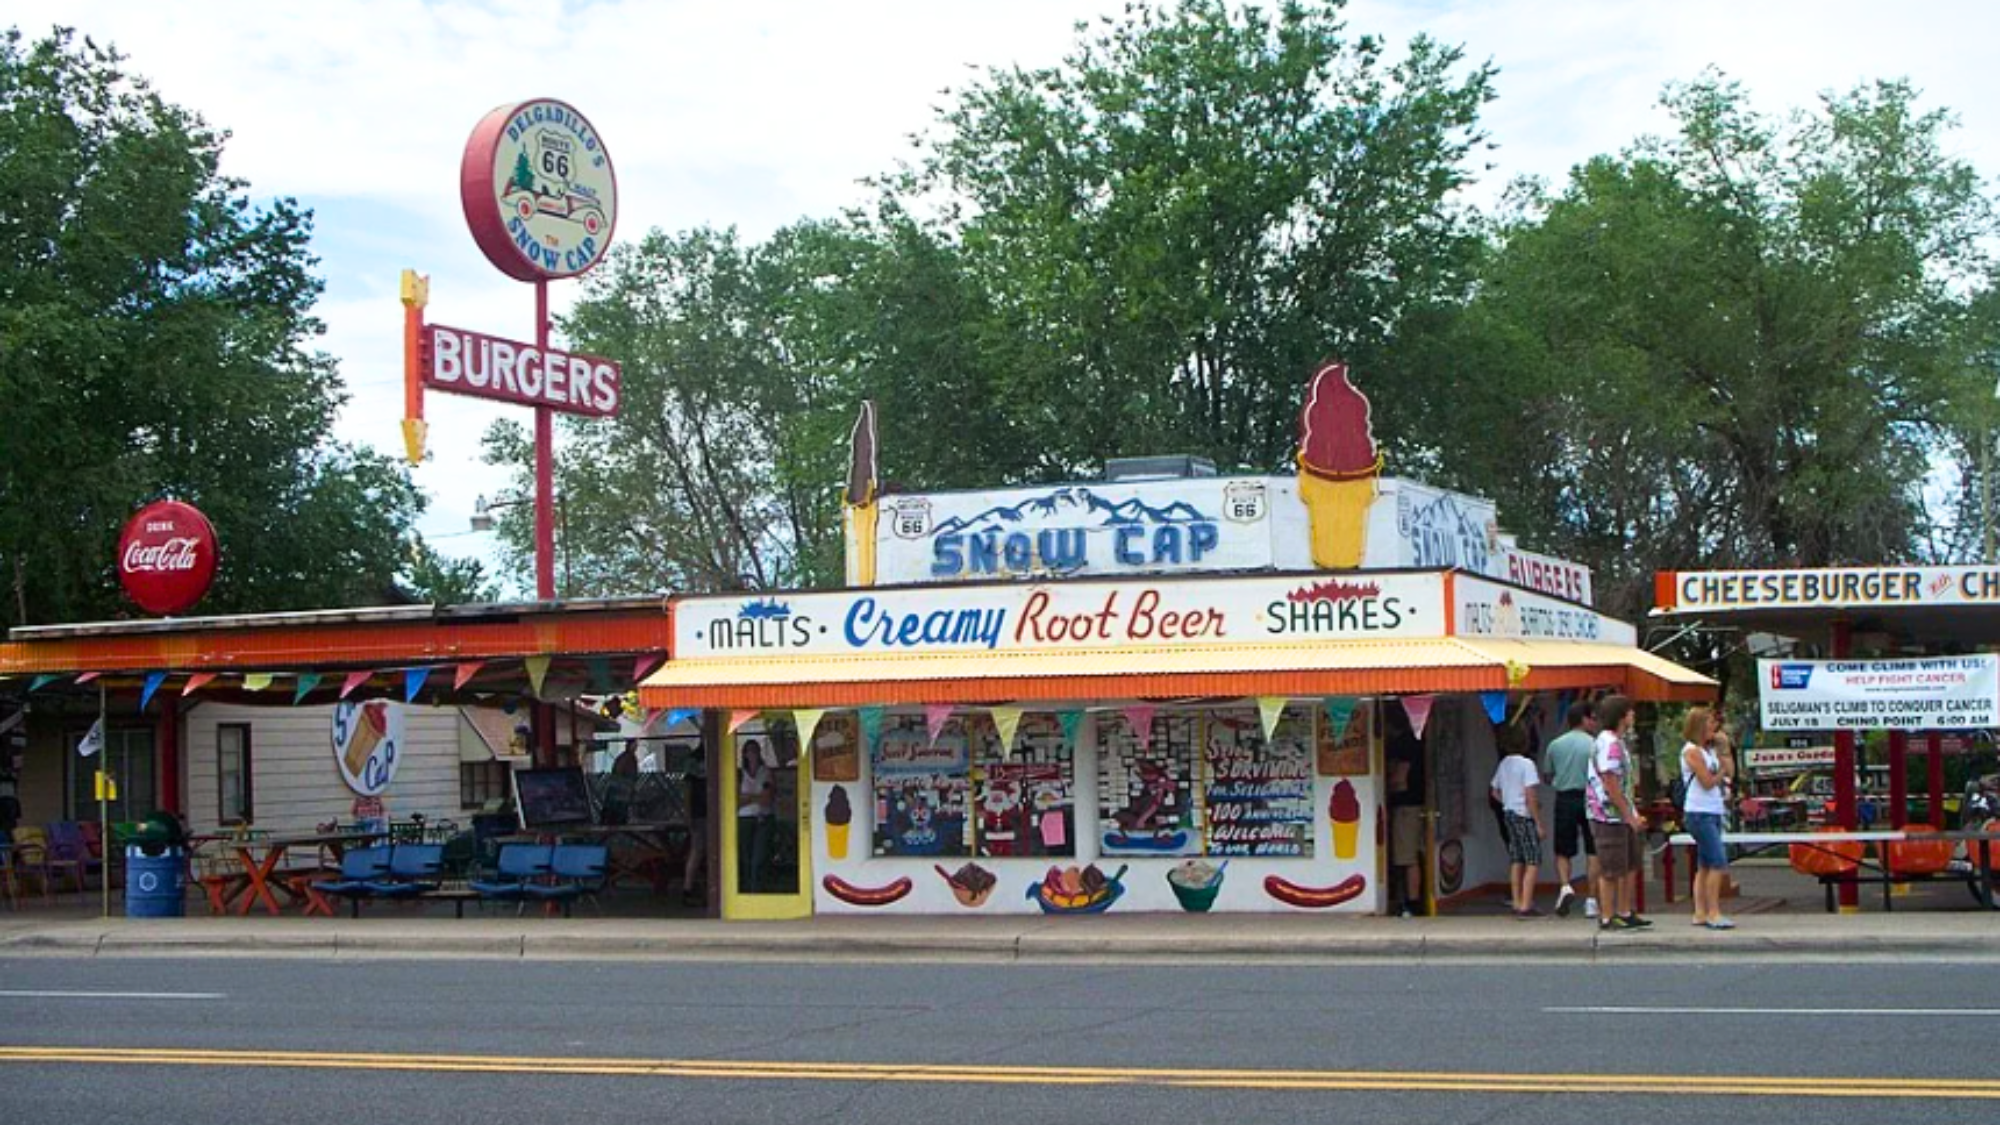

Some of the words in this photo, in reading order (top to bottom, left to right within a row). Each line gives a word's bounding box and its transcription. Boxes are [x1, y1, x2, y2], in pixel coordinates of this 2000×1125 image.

[506, 104, 605, 168] DELGADILLO'S
[542, 151, 568, 177] 66
[507, 216, 561, 271] SNOW
[566, 237, 596, 271] CAP
[434, 329, 618, 411] BURGERS
[1234, 504, 1256, 517] 66
[931, 527, 1088, 577] SNOW
[1114, 521, 1219, 566] CAP
[1682, 571, 1922, 604] CHEESEBURGER
[710, 615, 811, 650] MALTS
[844, 597, 1005, 650] Creamy
[1015, 588, 1119, 642] Root
[1126, 588, 1227, 640] Beer
[1267, 597, 1402, 634] SHAKES
[1826, 662, 1867, 673] COME
[1871, 661, 1917, 672] CLIMB
[1921, 660, 1958, 670] WITH
[1846, 674, 1875, 685] HELP
[1879, 673, 1915, 684] FIGHT
[1916, 672, 1966, 684] CANCER
[1768, 701, 1830, 714] SELIGMAN'S
[1835, 701, 1868, 714] CLIMB
[1870, 701, 1886, 713] TO
[1888, 700, 1942, 713] CONQUER
[1946, 699, 1992, 711] CANCER
[1769, 718, 1800, 726] JULY
[1883, 716, 1922, 726] POINT
[1937, 715, 1966, 725] 6:00
[1969, 715, 1990, 725] AM
